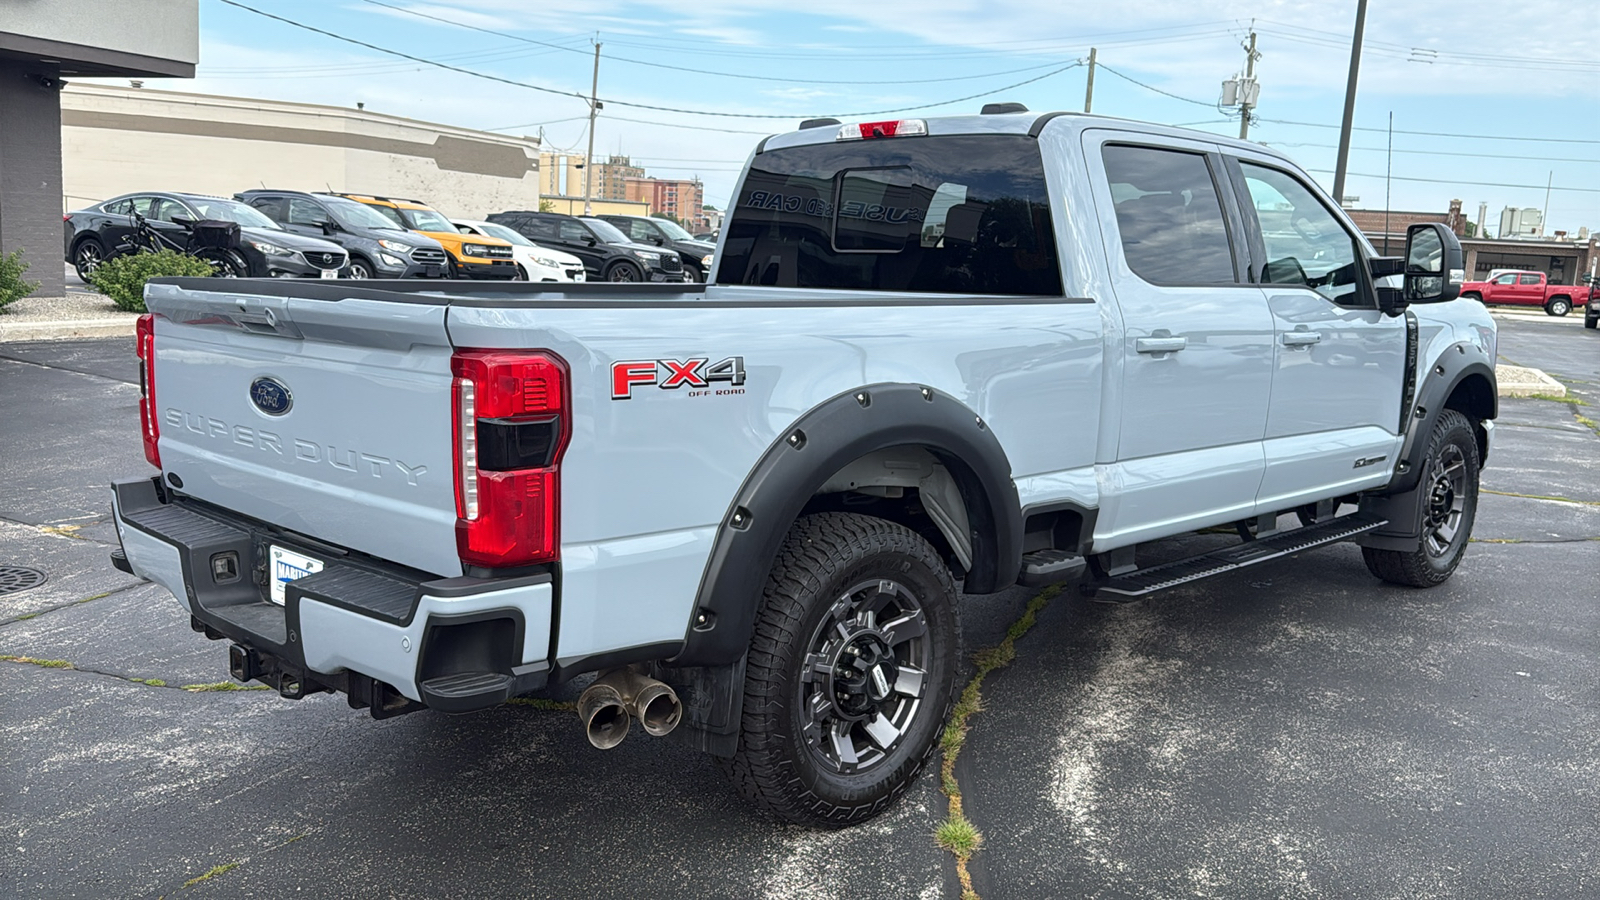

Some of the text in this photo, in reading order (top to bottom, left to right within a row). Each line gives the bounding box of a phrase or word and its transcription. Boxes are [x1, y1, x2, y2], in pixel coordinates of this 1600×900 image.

[254, 381, 284, 411] Ford
[610, 357, 746, 400] FX4
[715, 388, 746, 396] ROAD
[165, 407, 428, 487] SUPER DUTY
